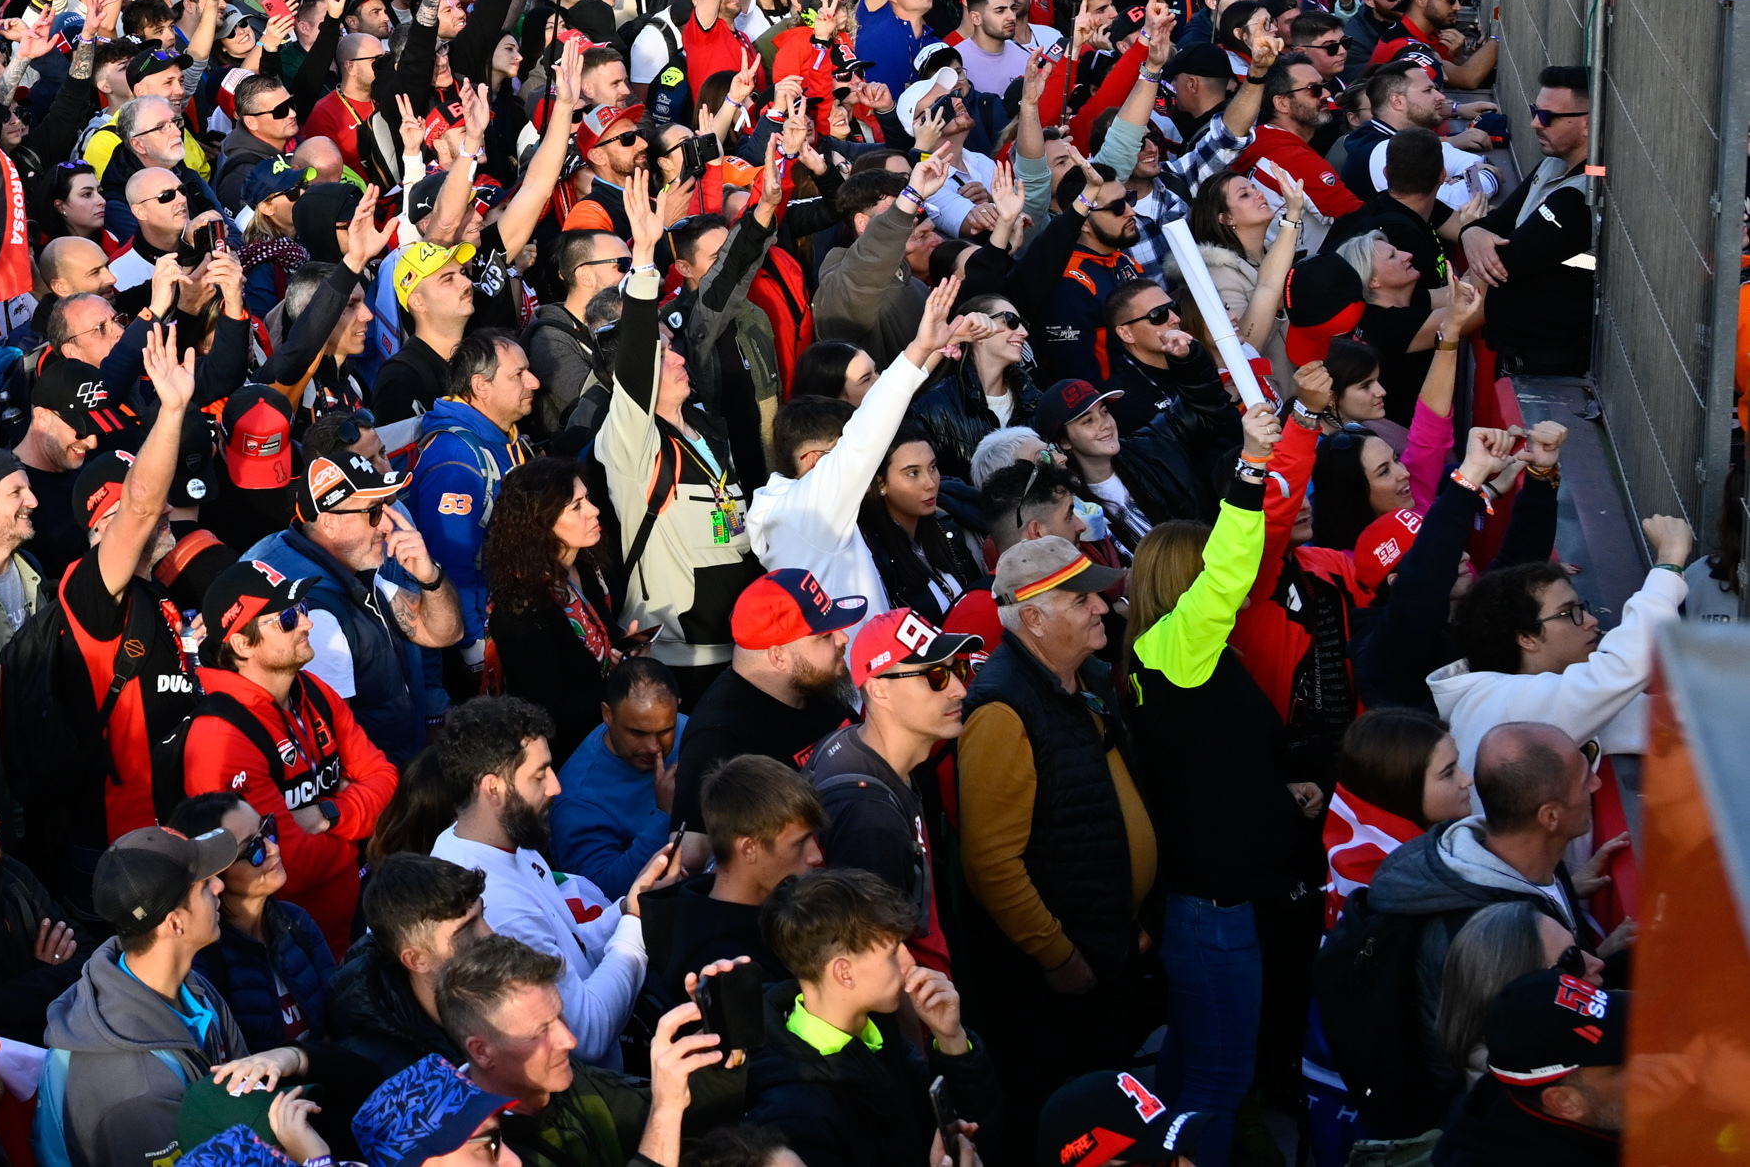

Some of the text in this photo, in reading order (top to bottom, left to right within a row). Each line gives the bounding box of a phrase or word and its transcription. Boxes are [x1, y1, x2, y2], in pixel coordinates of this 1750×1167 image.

[839, 44, 857, 62] 1
[437, 492, 473, 516] 53
[251, 560, 287, 588] 1
[1555, 974, 1596, 1015] 58
[1117, 1072, 1167, 1123] 1
